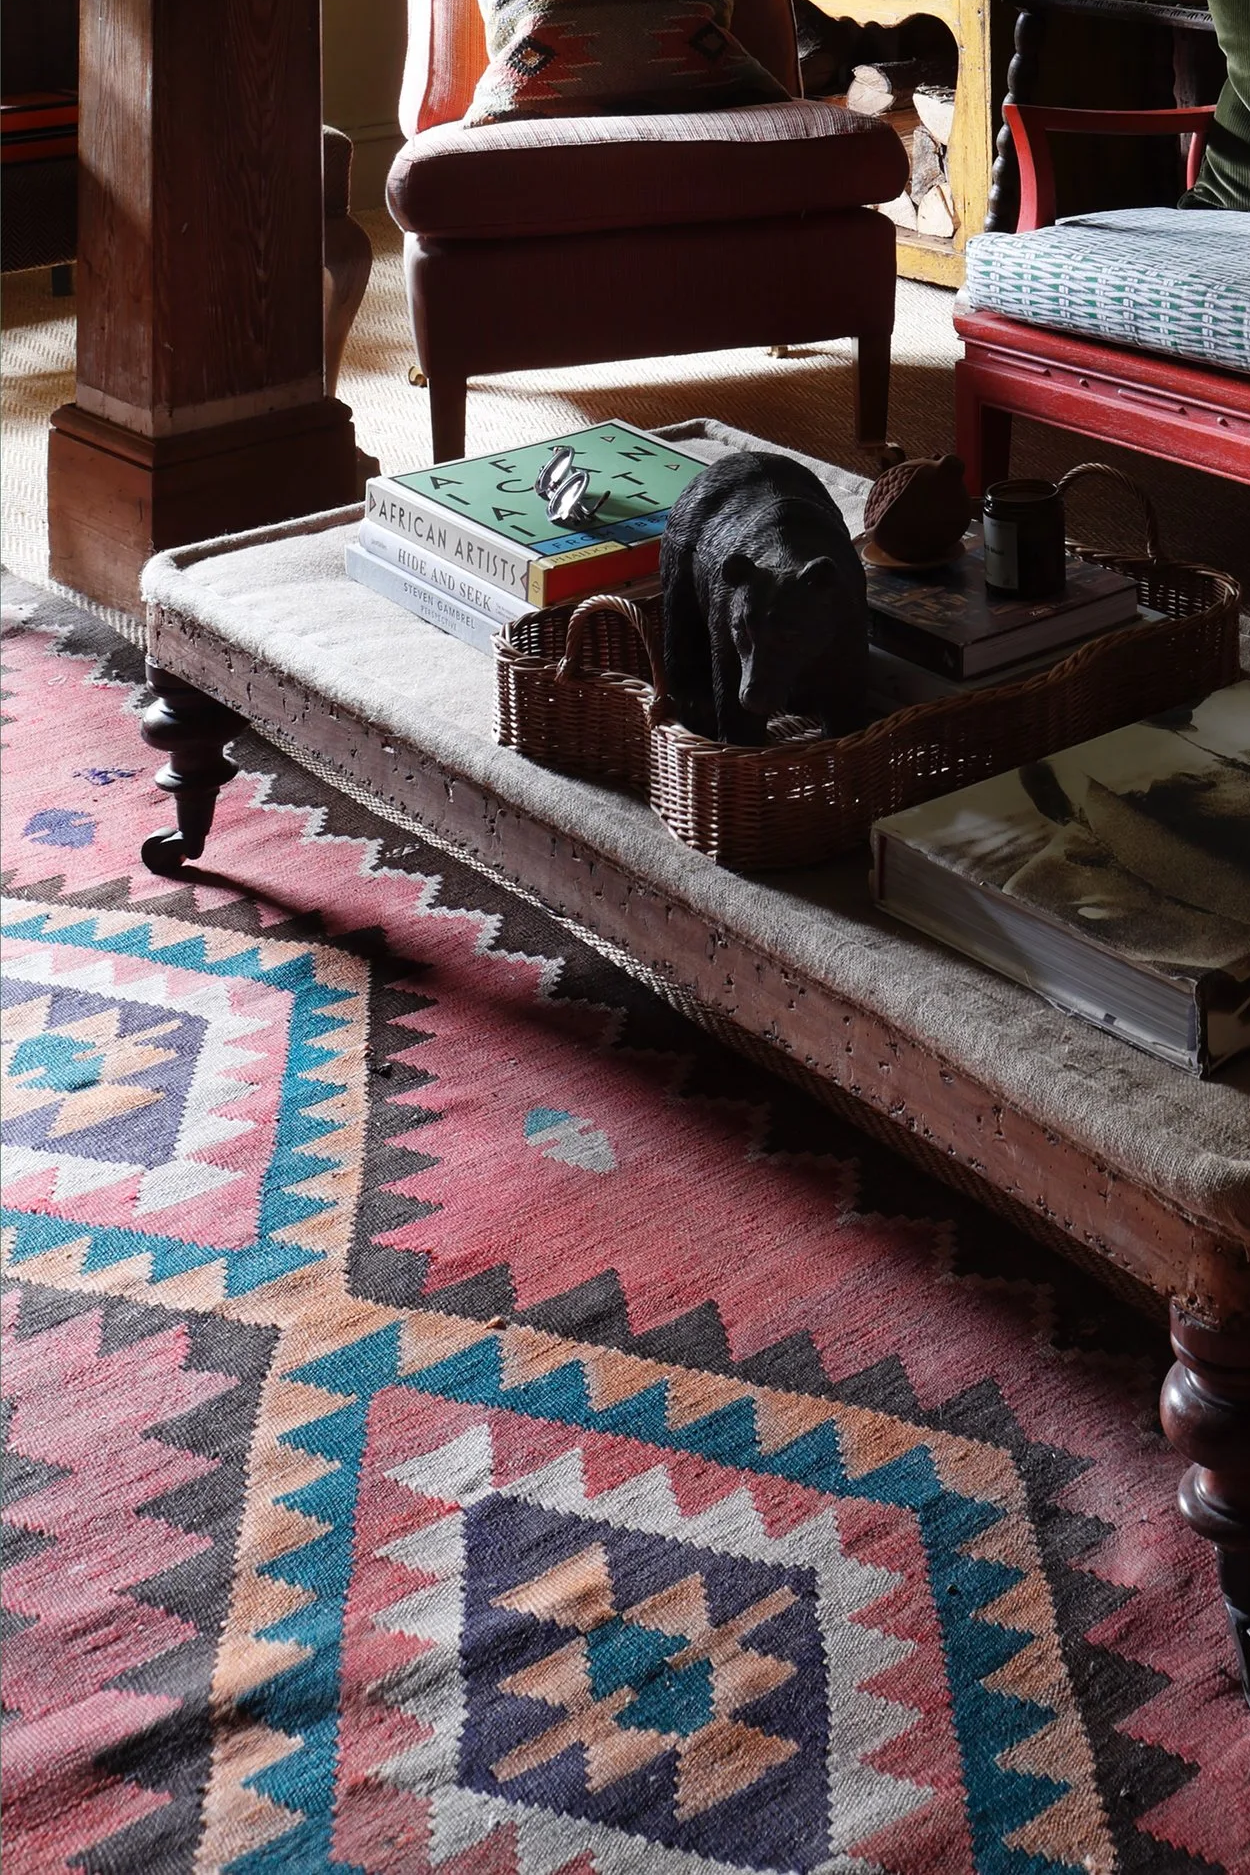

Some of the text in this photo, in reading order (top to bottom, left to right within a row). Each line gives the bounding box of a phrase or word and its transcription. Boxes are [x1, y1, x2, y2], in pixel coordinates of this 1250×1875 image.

[379, 500, 516, 586] AFRICAN ARTISTS
[398, 548, 427, 577] HIDE
[431, 567, 456, 591] AND
[459, 582, 492, 612] SEEK
[403, 582, 434, 606] STEVEN
[437, 600, 476, 630] GAMBREL
